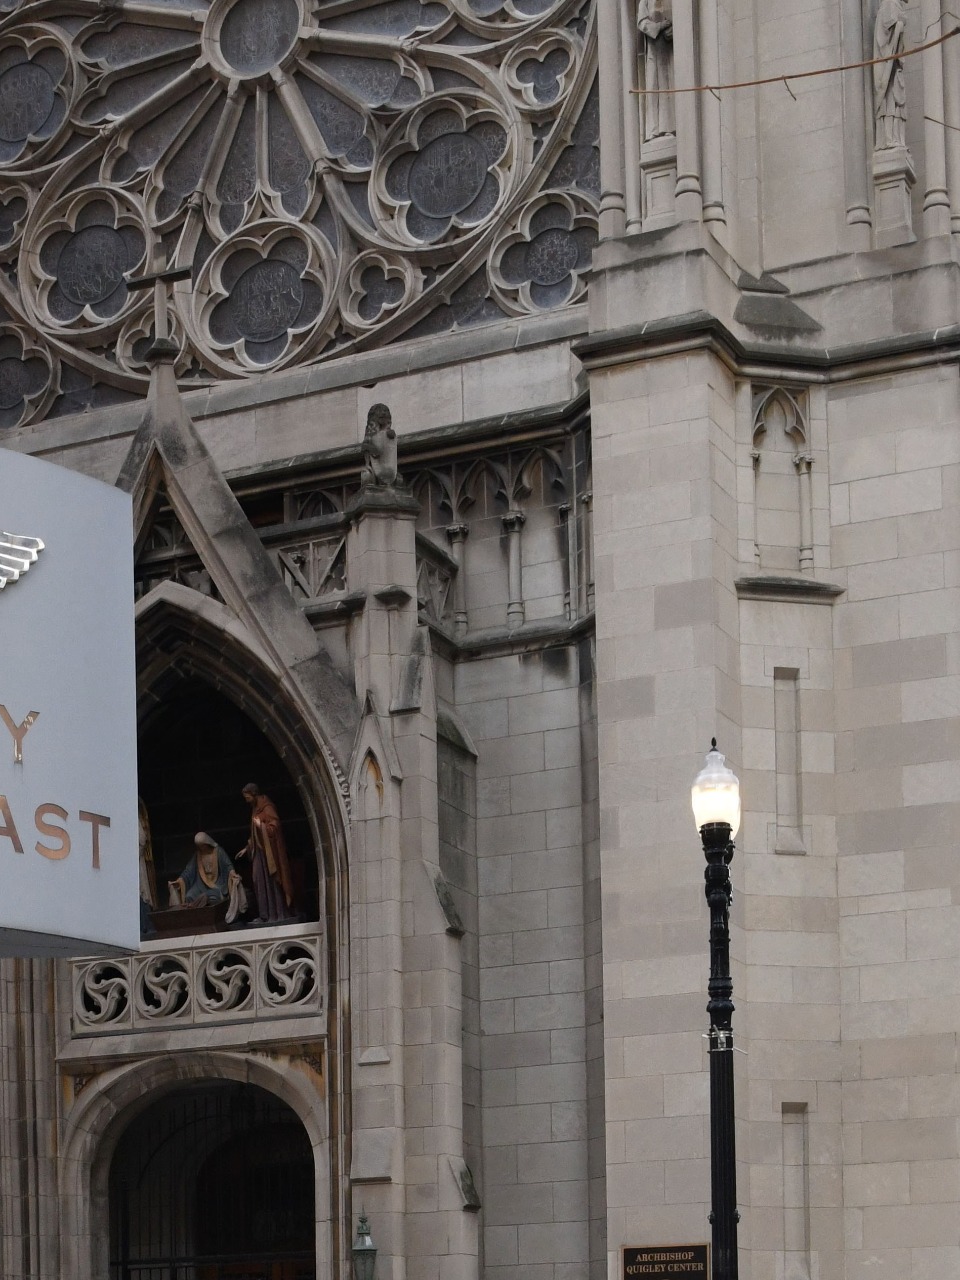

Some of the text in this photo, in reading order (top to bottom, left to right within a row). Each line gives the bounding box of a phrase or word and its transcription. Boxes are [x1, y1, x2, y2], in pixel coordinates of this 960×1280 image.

[635, 1251, 695, 1262] ARCHBISHOP
[626, 1262, 704, 1275] QUIGLEY CENTER
